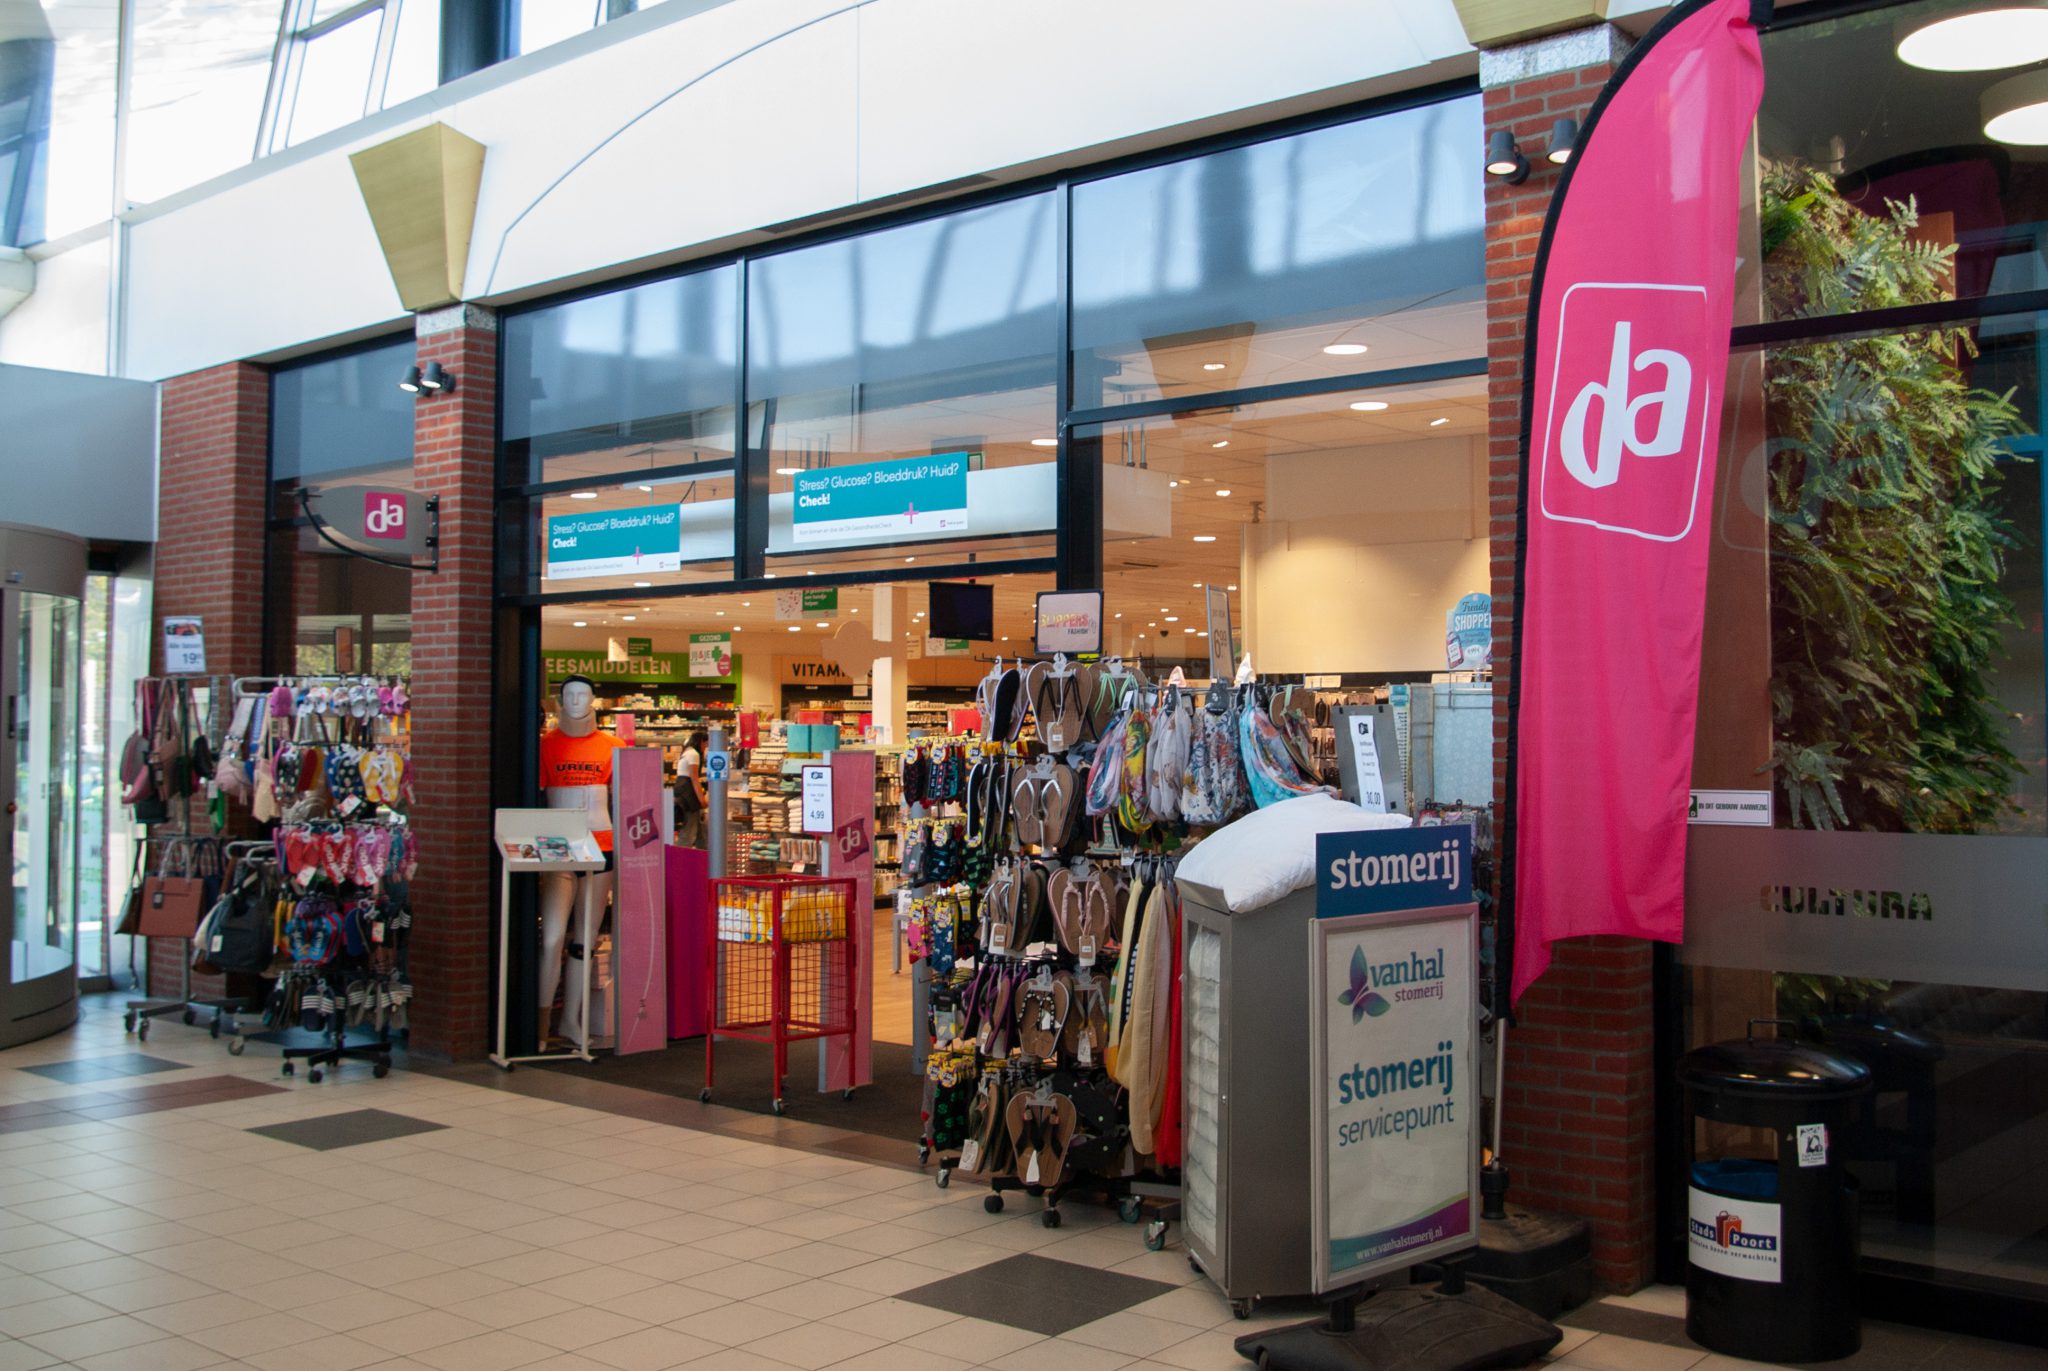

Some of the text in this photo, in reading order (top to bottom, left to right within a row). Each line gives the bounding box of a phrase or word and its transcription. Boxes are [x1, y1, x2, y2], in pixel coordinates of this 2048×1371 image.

[1559, 320, 1692, 489] da
[799, 462, 959, 492] Stress? Glucose? Bloeddruk? Huid?
[799, 493, 830, 507] Check!
[366, 498, 404, 533] da
[552, 512, 675, 535] Stress? Glucose? Bloeddruk? Huid?
[552, 536, 577, 548] Check!
[792, 663, 845, 677] VITAM
[556, 762, 603, 773] URIEL
[628, 816, 651, 840] da
[810, 810, 825, 820] 4,99
[839, 827, 861, 853] da
[1330, 839, 1459, 890] stomerij
[1760, 885, 1932, 920] CULTURA
[1370, 948, 1445, 988] vanhal
[1394, 981, 1444, 1002] stomerij
[1338, 1040, 1453, 1105] stomerij
[1338, 1096, 1454, 1147] servicepunt
[1356, 1225, 1443, 1259] www.vanhalstomerij.nl
[1691, 1220, 1772, 1249] Stads Poort
[1731, 1252, 1777, 1263] verwachting
